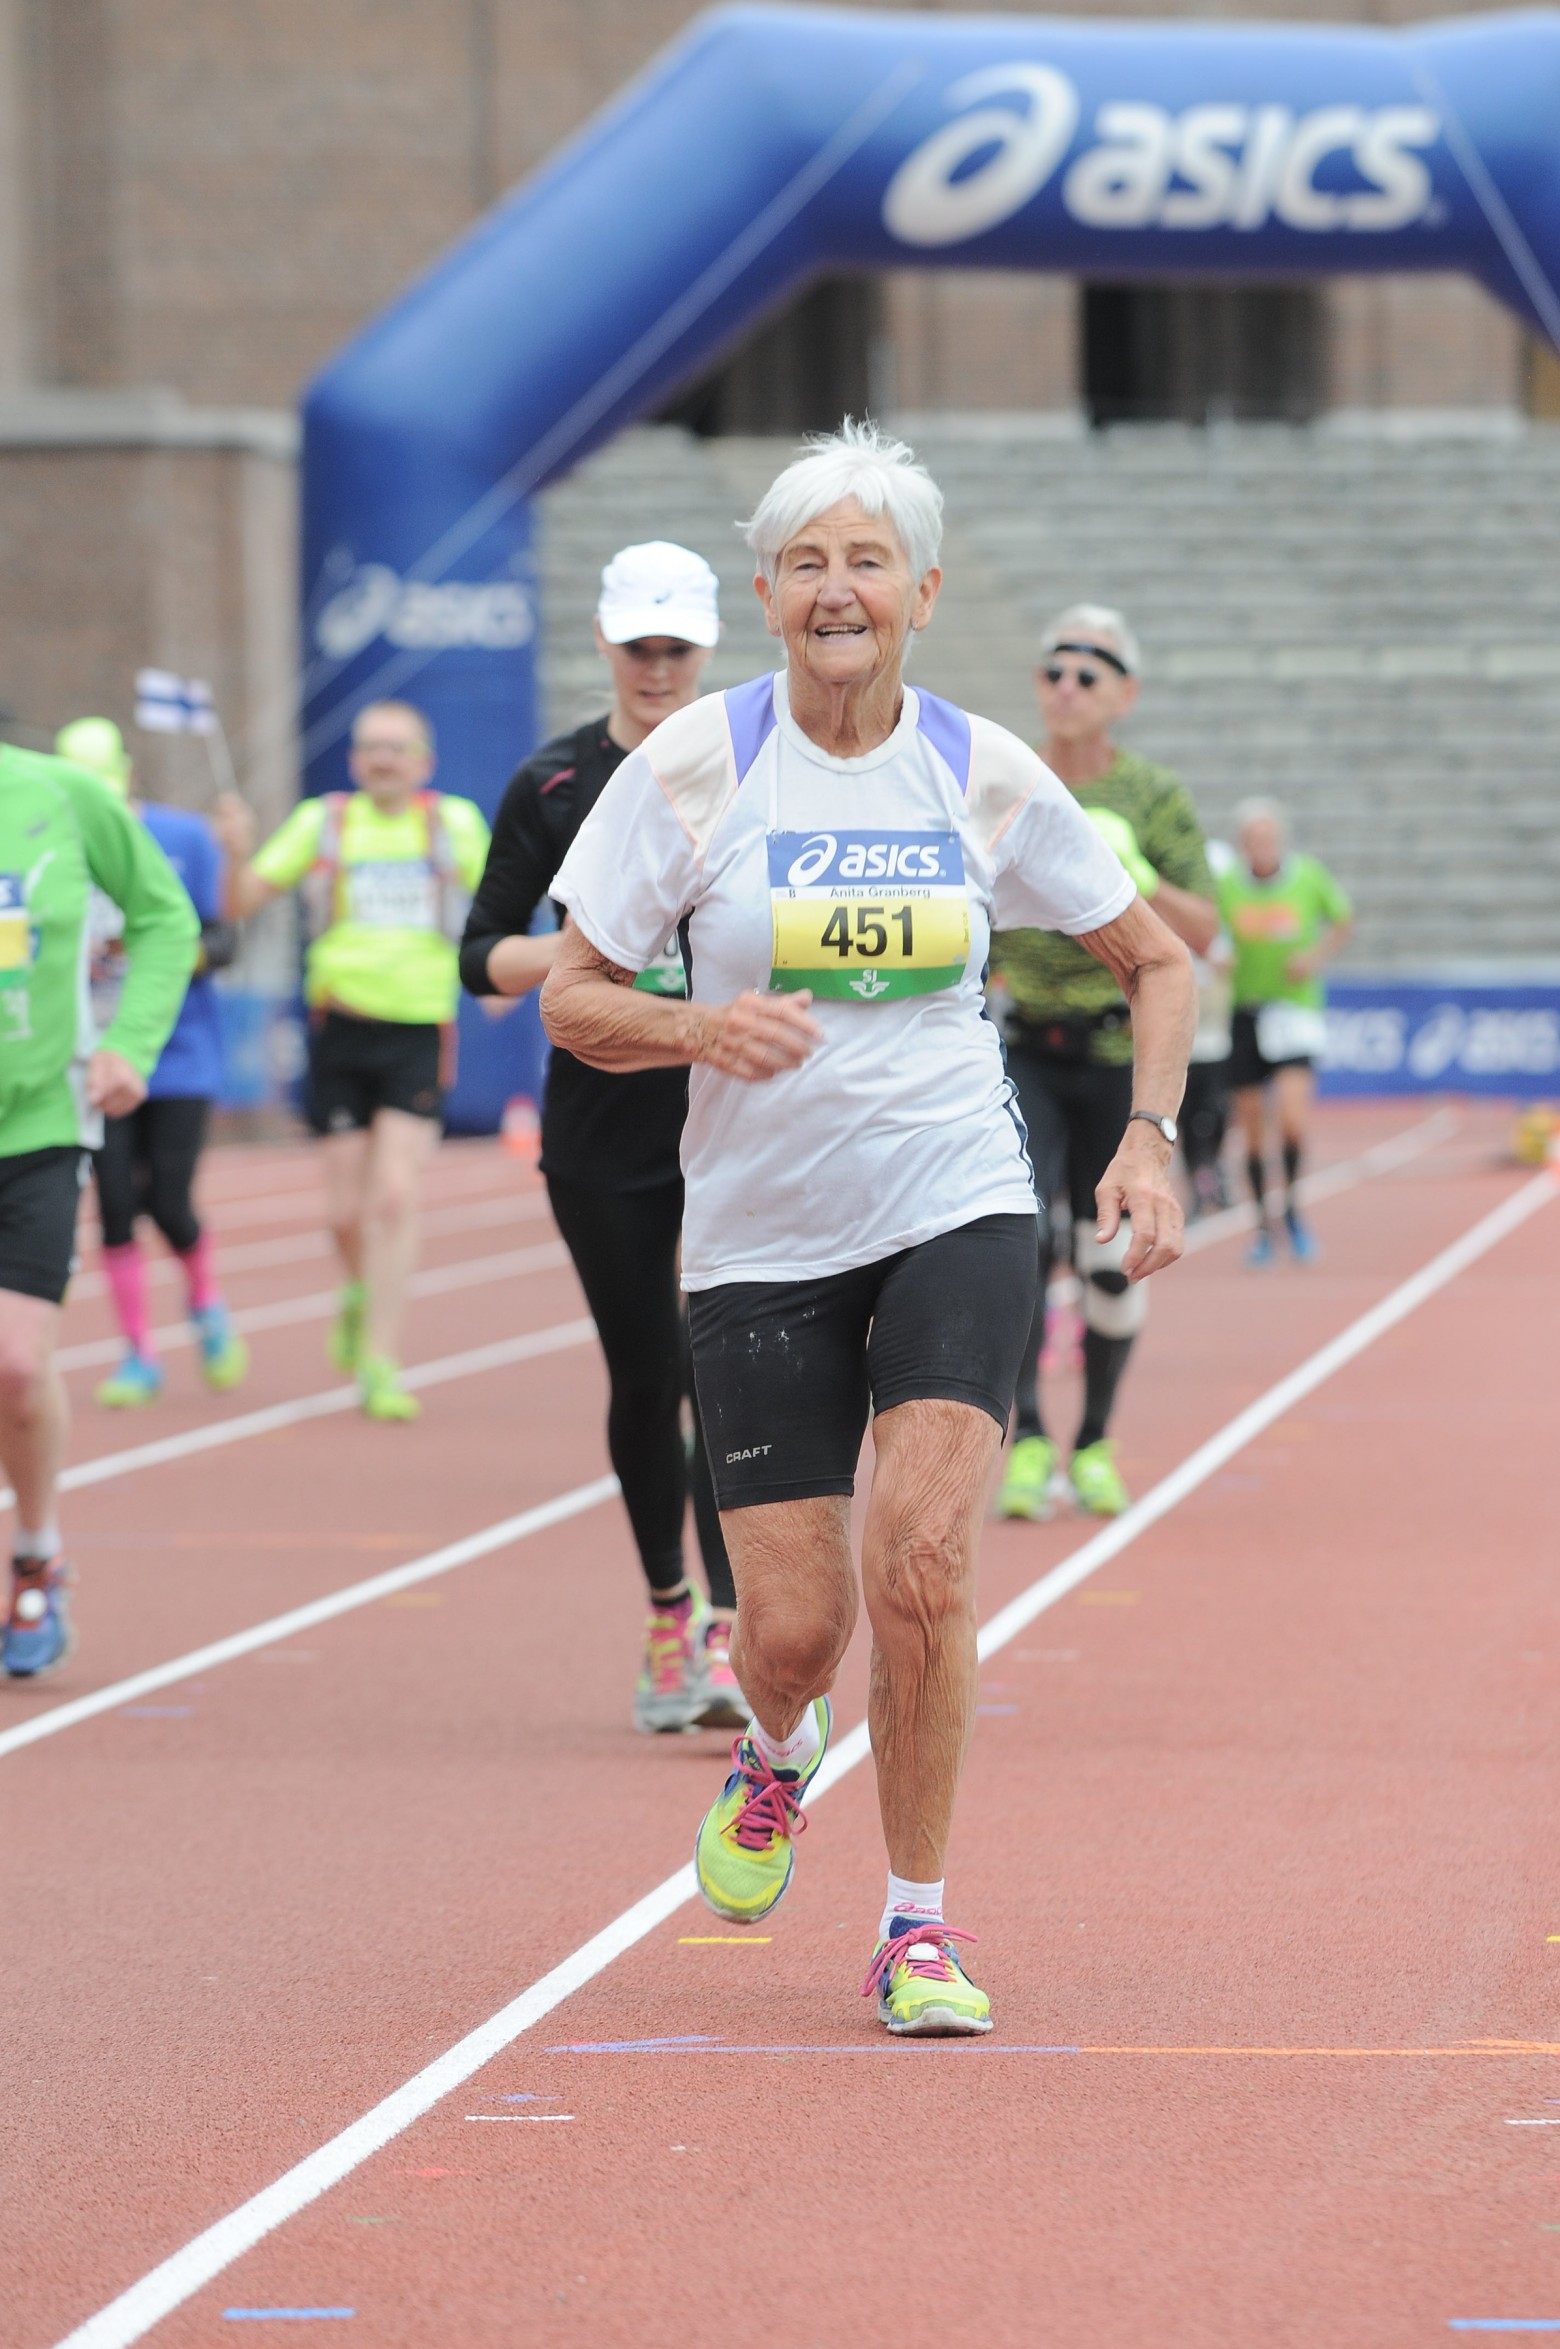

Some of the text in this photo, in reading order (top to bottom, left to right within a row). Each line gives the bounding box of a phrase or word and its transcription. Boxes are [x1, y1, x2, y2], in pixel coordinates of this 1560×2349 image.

[1062, 103, 1441, 232] asics
[839, 844, 940, 878] asics
[788, 885, 931, 899] B Anita Granberg
[820, 905, 913, 957] 451
[726, 1444, 772, 1464] CRAFT
